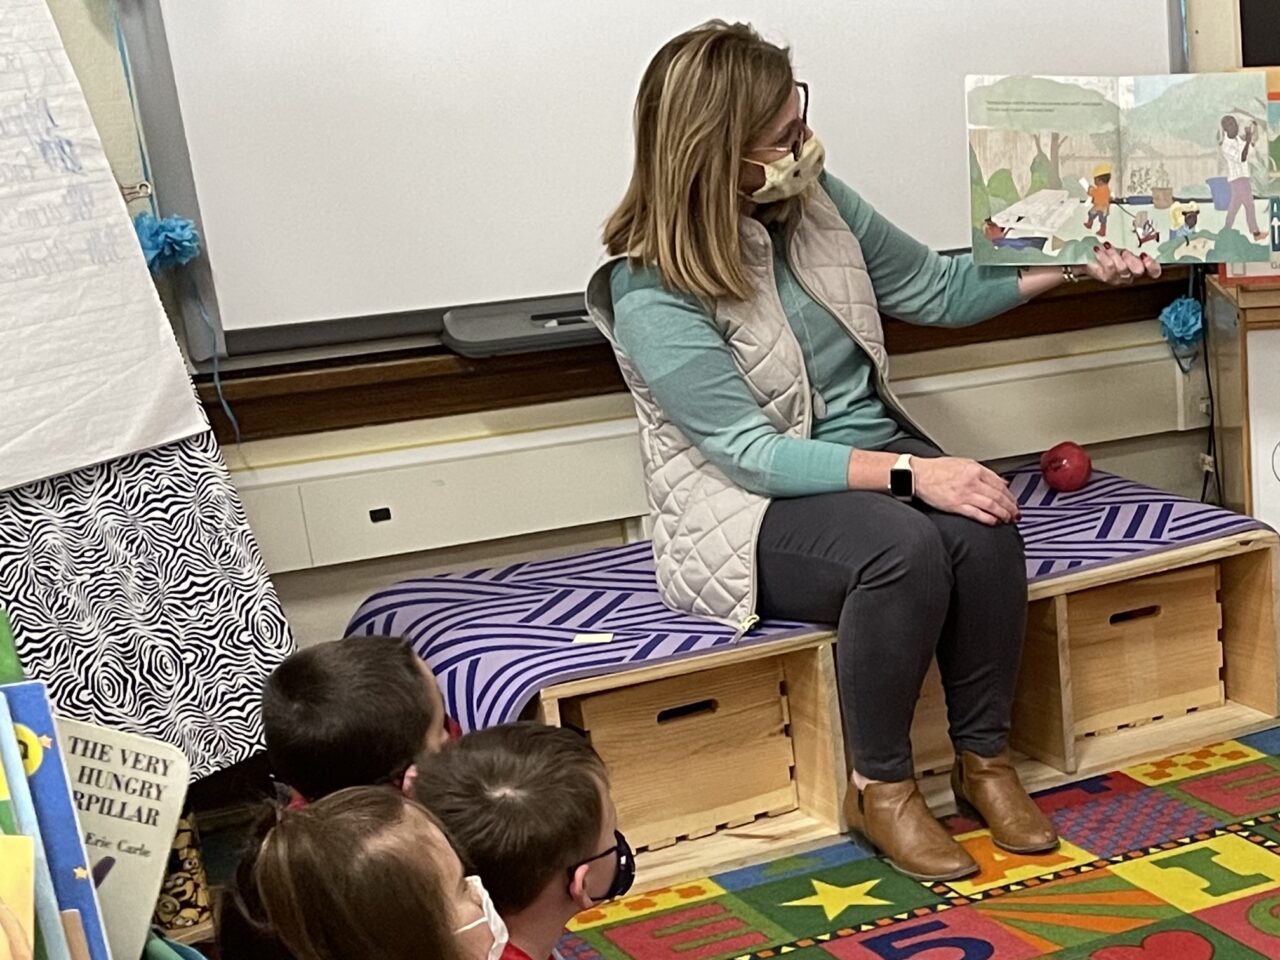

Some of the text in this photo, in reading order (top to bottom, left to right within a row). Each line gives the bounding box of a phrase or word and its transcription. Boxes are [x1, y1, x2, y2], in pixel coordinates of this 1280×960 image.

[68, 735, 175, 777] THE VERY
[77, 765, 168, 802] HUNGRY
[85, 832, 152, 857] Eric Carle
